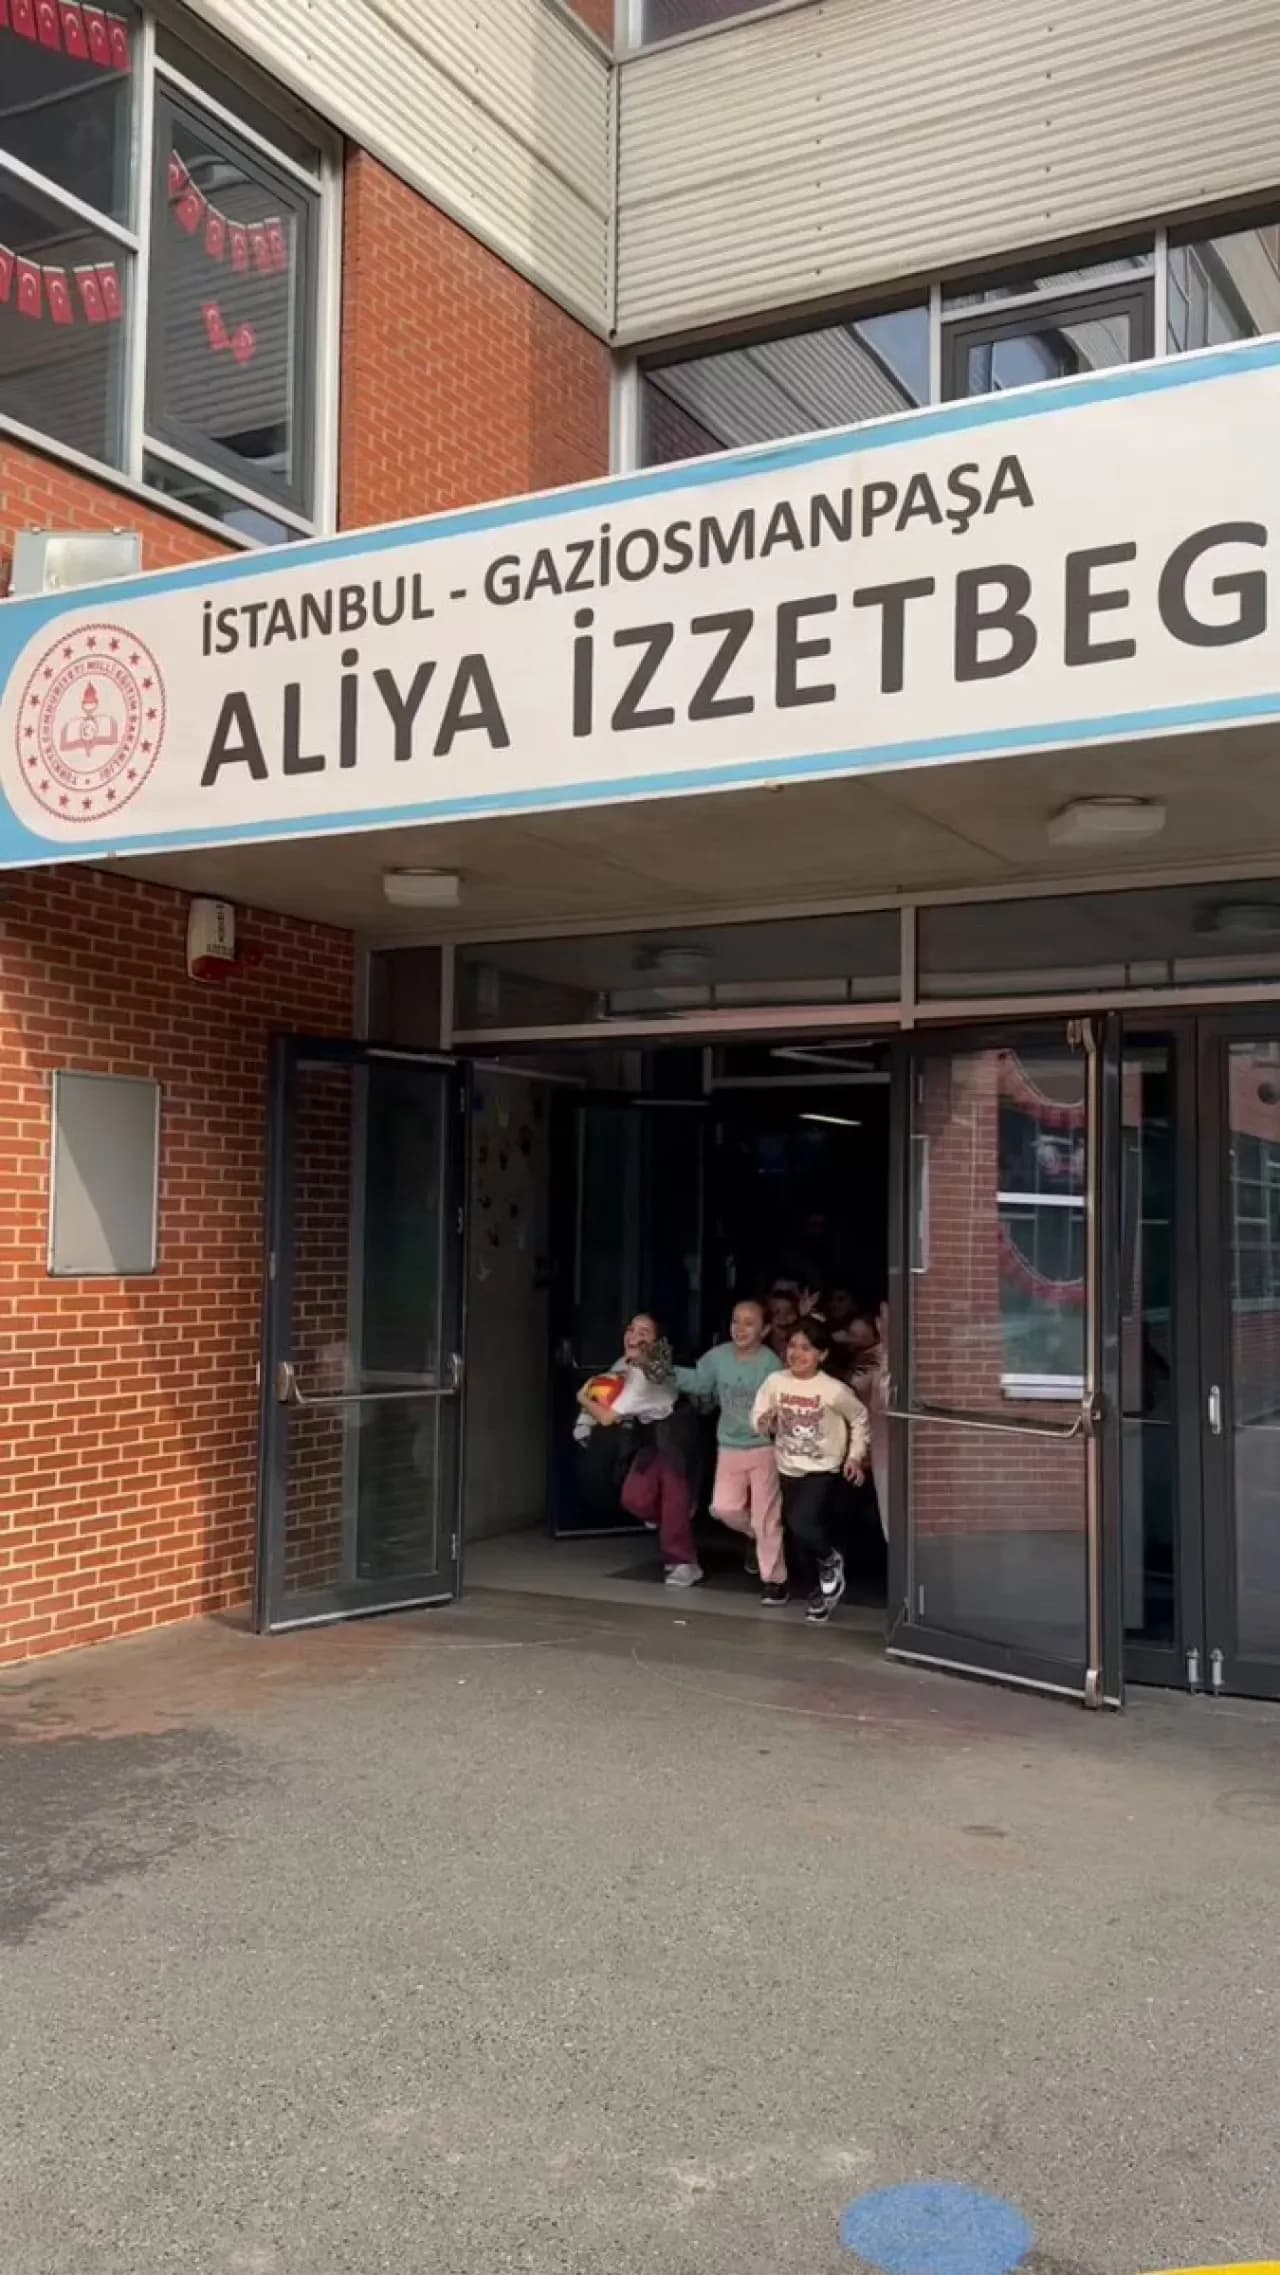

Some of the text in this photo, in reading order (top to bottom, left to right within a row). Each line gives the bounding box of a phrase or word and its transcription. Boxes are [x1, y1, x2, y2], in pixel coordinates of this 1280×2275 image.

[200, 521, 1269, 787] ALİYA İZZETBEG
[202, 454, 1034, 657] İSTANBUL - GAZİOSMANPAŞA
